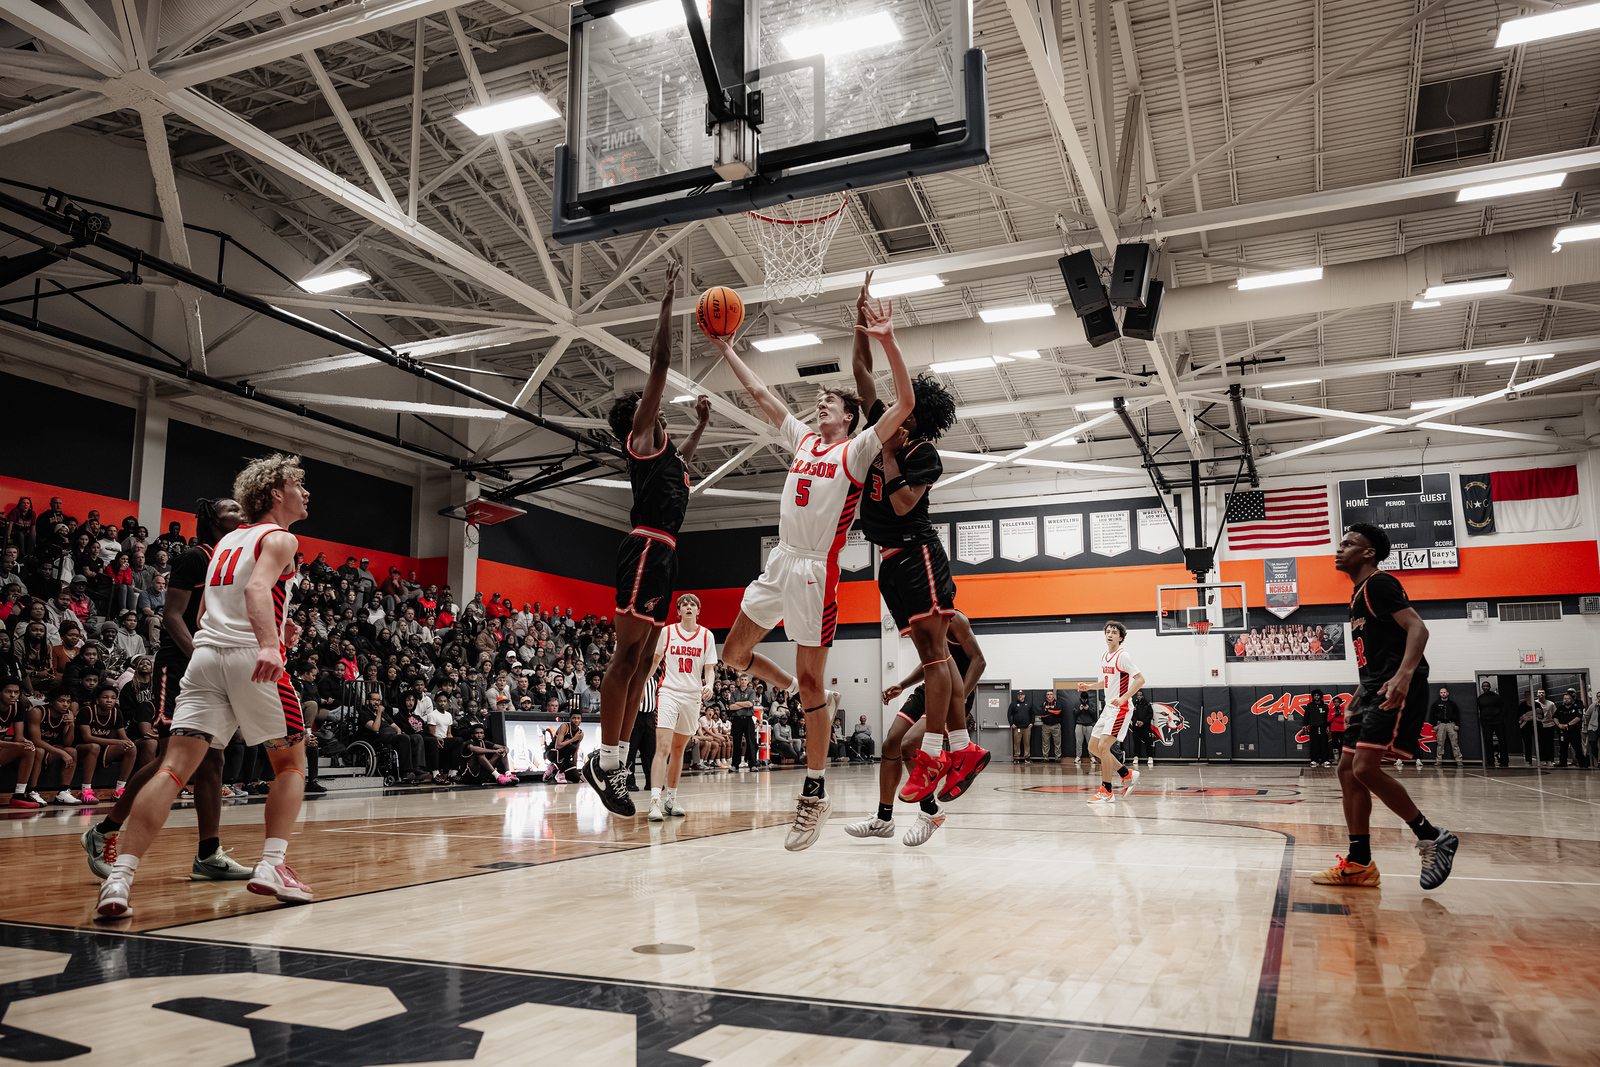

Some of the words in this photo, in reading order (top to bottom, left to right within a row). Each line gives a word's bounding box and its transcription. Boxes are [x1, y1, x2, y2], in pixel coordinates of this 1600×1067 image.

[795, 478, 812, 507] 5
[1420, 493, 1447, 502] GUEST
[1346, 499, 1369, 507] HOME
[1466, 500, 1473, 509] N
[1482, 498, 1489, 508] C
[210, 547, 244, 586] 11
[1270, 586, 1293, 594] NCHSAA
[670, 646, 702, 657] CARSON
[678, 658, 693, 673] 10
